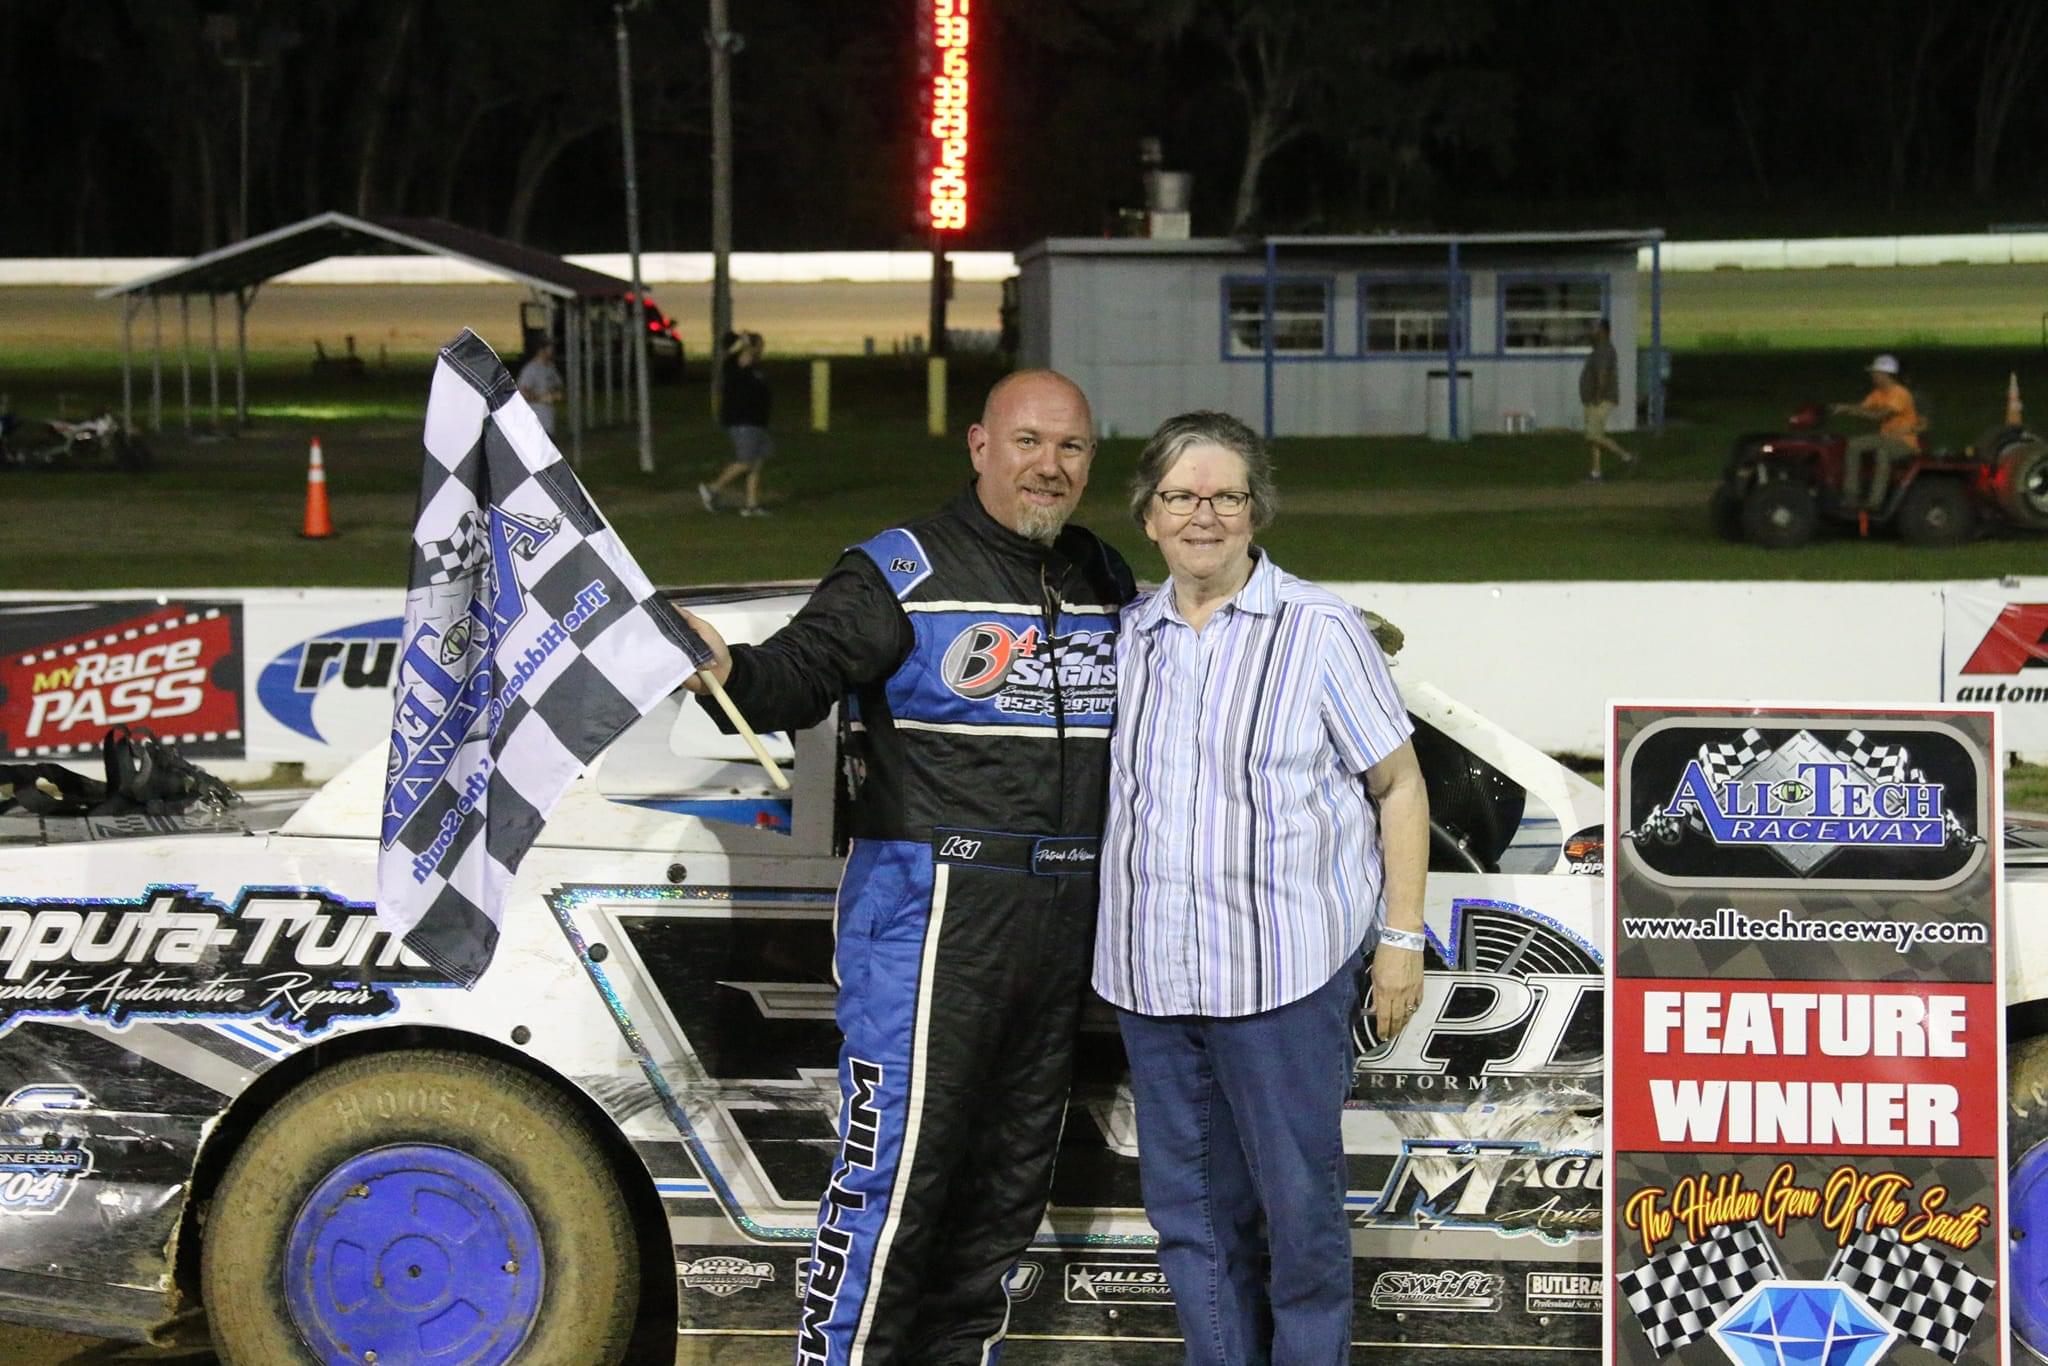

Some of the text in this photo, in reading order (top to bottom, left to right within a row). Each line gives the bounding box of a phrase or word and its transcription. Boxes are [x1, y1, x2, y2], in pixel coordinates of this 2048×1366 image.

[297, 641, 399, 697] ru
[25, 668, 207, 738] PASS
[1663, 760, 1945, 822] ALL TECH
[1731, 820, 1933, 842] RACEWAY
[1570, 863, 1604, 874] POP
[1624, 908, 1985, 953] www.alltechraceway.com
[67, 968, 250, 1010] Automotive
[256, 971, 373, 1021] Repair
[1643, 991, 1967, 1058] FEATURE
[1649, 1079, 1960, 1146] WINNER
[796, 1056, 883, 1366] WILLIAM
[1624, 1163, 1990, 1257] The Hidden Gem Of The South
[676, 1265, 771, 1276] RACECAR
